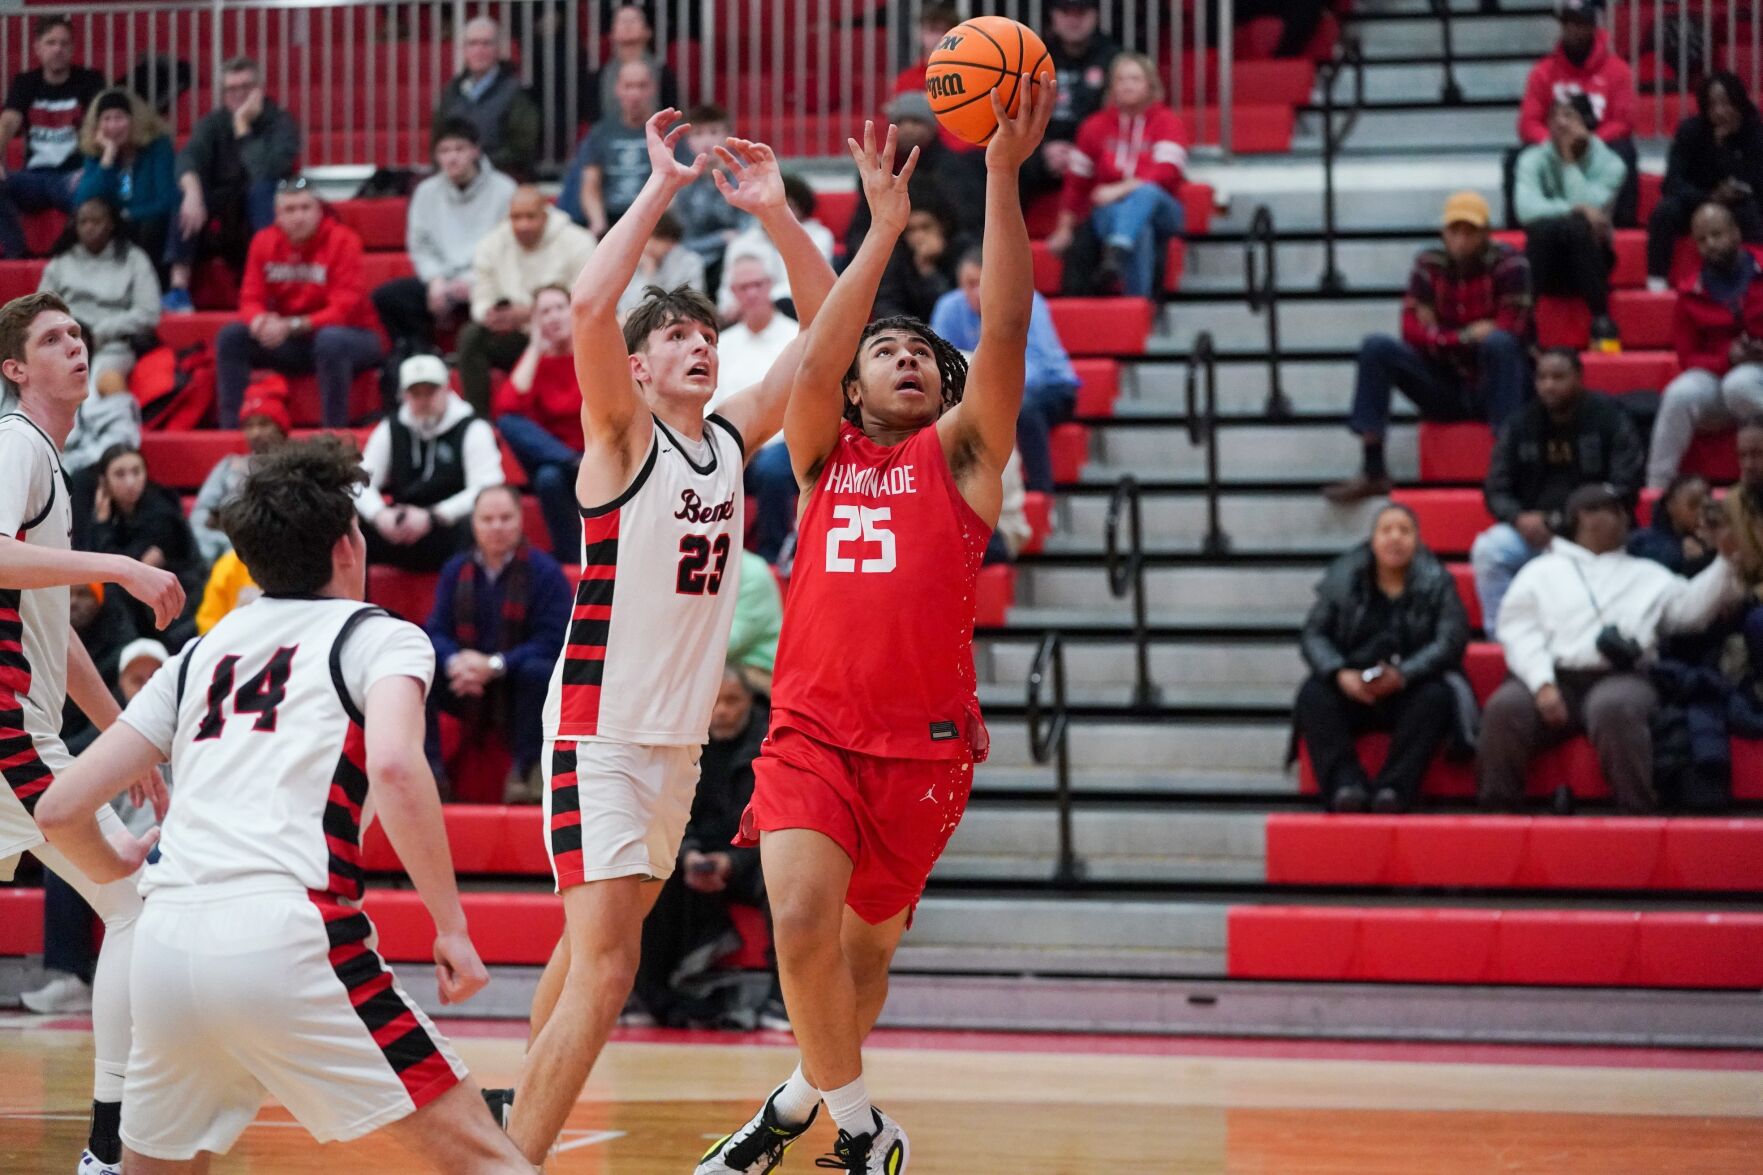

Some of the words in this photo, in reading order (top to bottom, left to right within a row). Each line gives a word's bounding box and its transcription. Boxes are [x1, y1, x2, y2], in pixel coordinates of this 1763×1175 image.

[675, 532, 731, 595] 23
[825, 504, 897, 573] 25
[192, 643, 300, 742] 14
